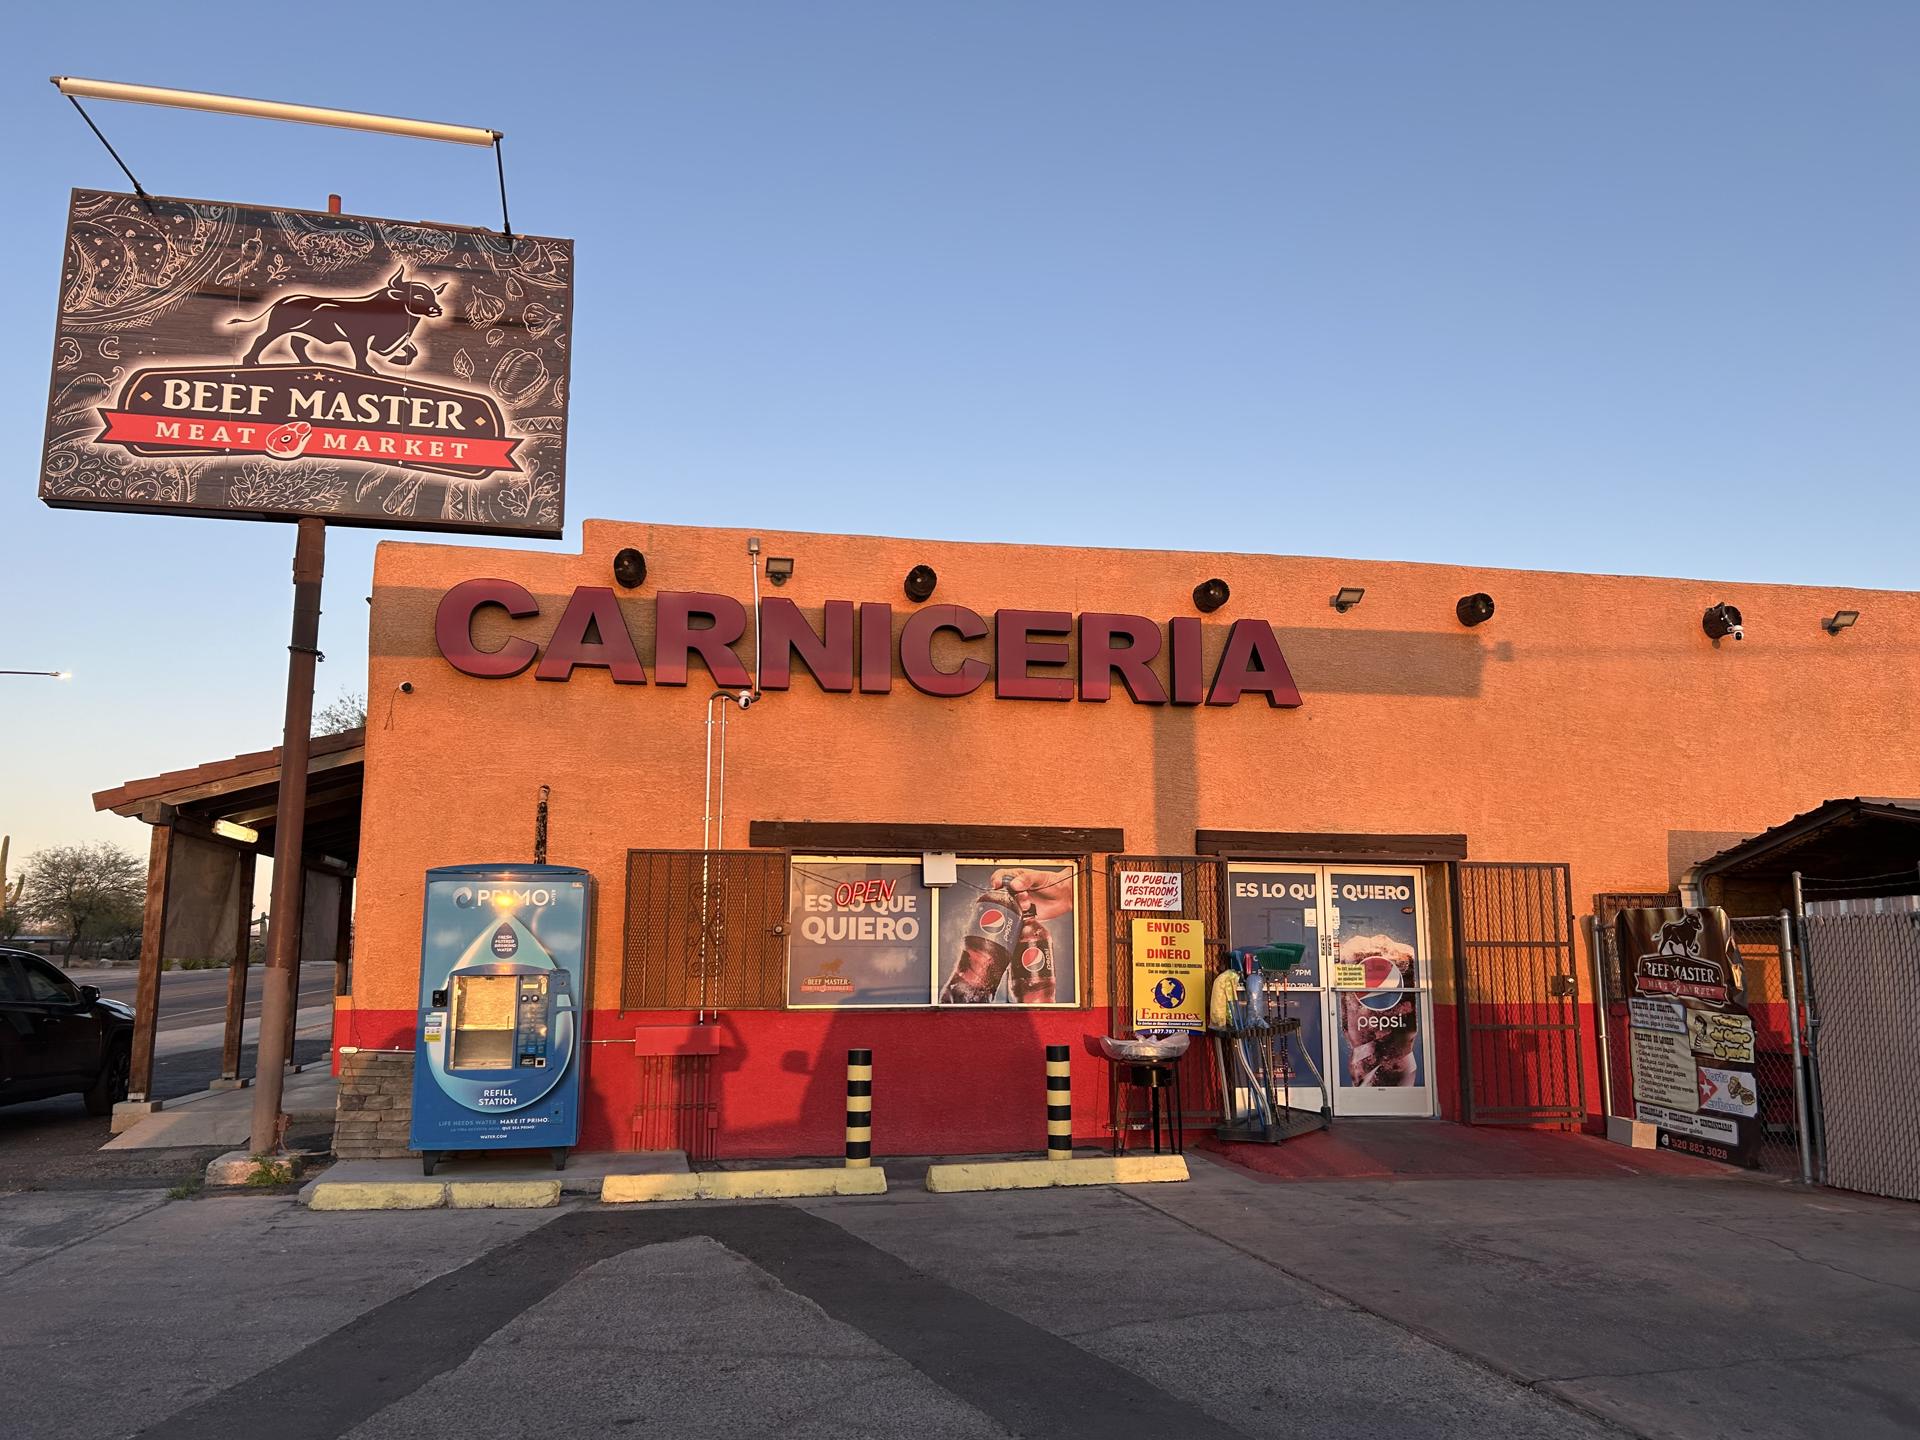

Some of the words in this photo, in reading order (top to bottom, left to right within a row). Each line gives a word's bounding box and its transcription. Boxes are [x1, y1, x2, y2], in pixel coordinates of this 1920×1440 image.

[162, 379, 274, 419] BEEF
[288, 387, 465, 432] MASTER
[155, 421, 257, 446] MEAT
[322, 433, 470, 460] MARKET
[435, 578, 1303, 709] CARNICERIA
[1125, 875, 1139, 884] NO
[1142, 875, 1178, 884] PUBLIC
[835, 879, 897, 906] OPEN
[1126, 886, 1178, 897] RESTROOMS
[1235, 882, 1259, 898] ES
[1262, 883, 1286, 898] LO
[1342, 884, 1410, 902] QUIERO
[804, 894, 833, 912] ES
[870, 895, 917, 915] QUE
[1134, 898, 1164, 907] PHONE
[801, 916, 920, 945] QUIERO
[1146, 922, 1190, 933] ENVIOS
[1161, 936, 1176, 946] DE
[1146, 948, 1190, 960] DINERO
[1646, 962, 1670, 978] BEEF
[1670, 965, 1715, 983] MASTER
[1141, 1008, 1200, 1020] Enramex
[1358, 1013, 1402, 1030] pepsi
[484, 1089, 512, 1097] REFILL
[478, 1098, 517, 1106] STATION
[1671, 1138, 1687, 1150] 520
[1689, 1143, 1705, 1153] 882
[1706, 1146, 1728, 1160] 3028
